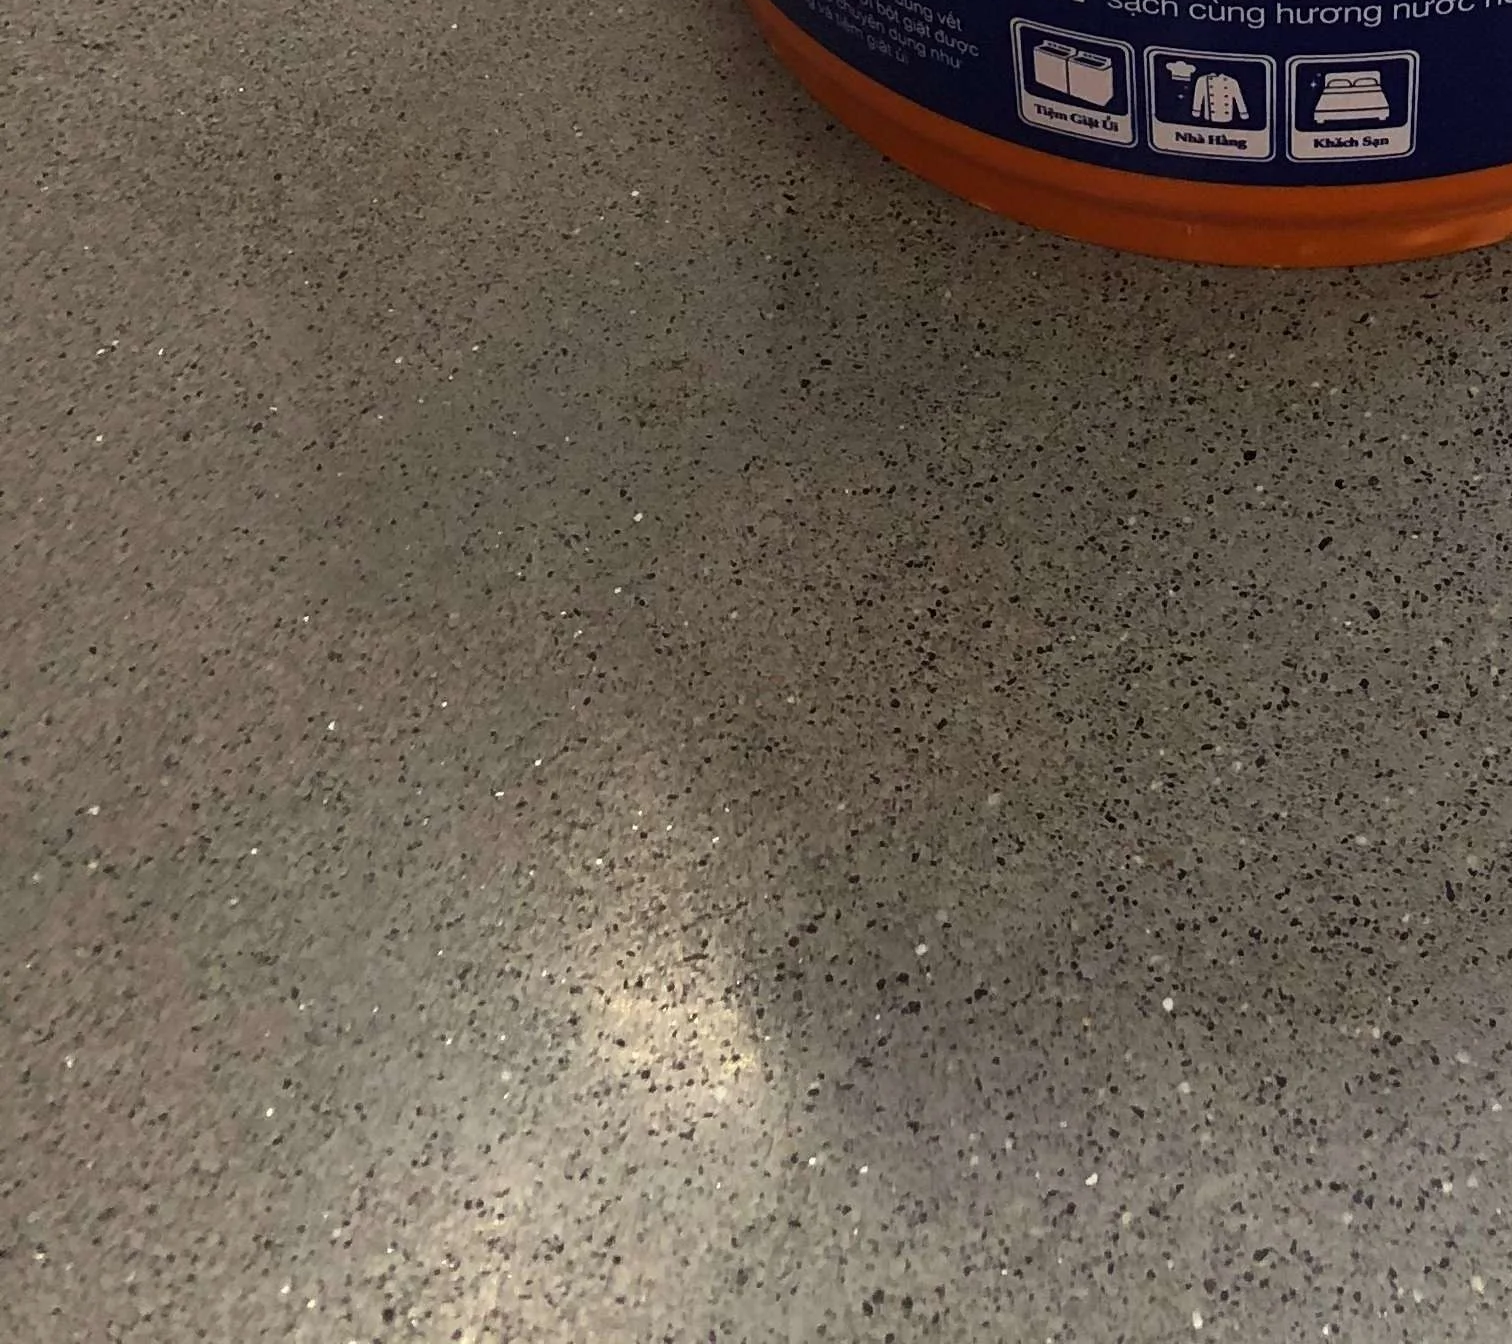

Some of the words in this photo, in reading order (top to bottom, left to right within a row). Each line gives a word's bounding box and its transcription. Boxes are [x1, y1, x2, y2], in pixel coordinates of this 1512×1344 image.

[1276, 2, 1383, 29] hương
[1175, 131, 1206, 144] Nhà
[1208, 135, 1247, 149] Hàng
[1313, 137, 1359, 149] Khách
[1362, 136, 1390, 149] Sạn
